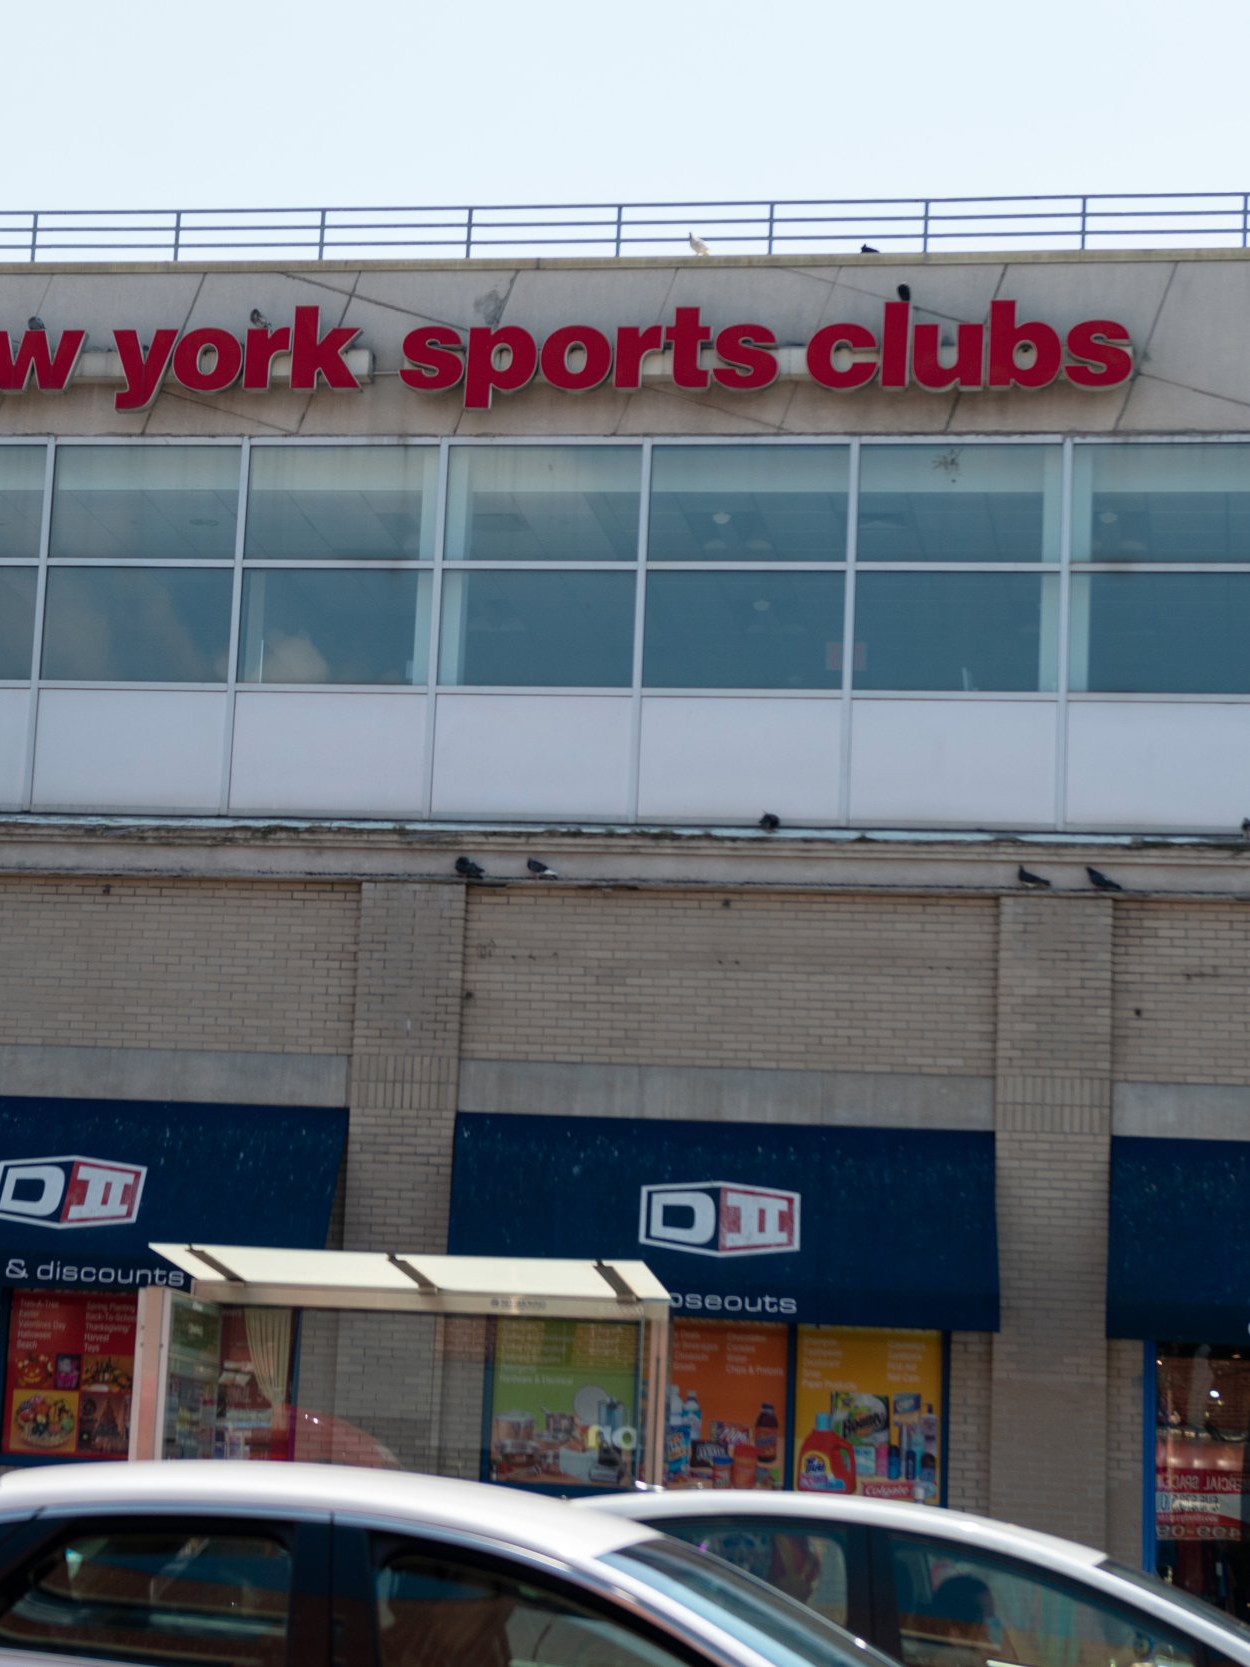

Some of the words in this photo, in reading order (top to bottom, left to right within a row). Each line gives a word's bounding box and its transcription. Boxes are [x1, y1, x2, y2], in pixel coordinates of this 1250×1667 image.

[113, 305, 363, 412] york
[399, 306, 778, 410] sports
[806, 299, 1134, 390] clubs
[5, 1259, 29, 1279] &
[36, 1261, 185, 1287] discounts
[669, 1292, 798, 1314] oseouts
